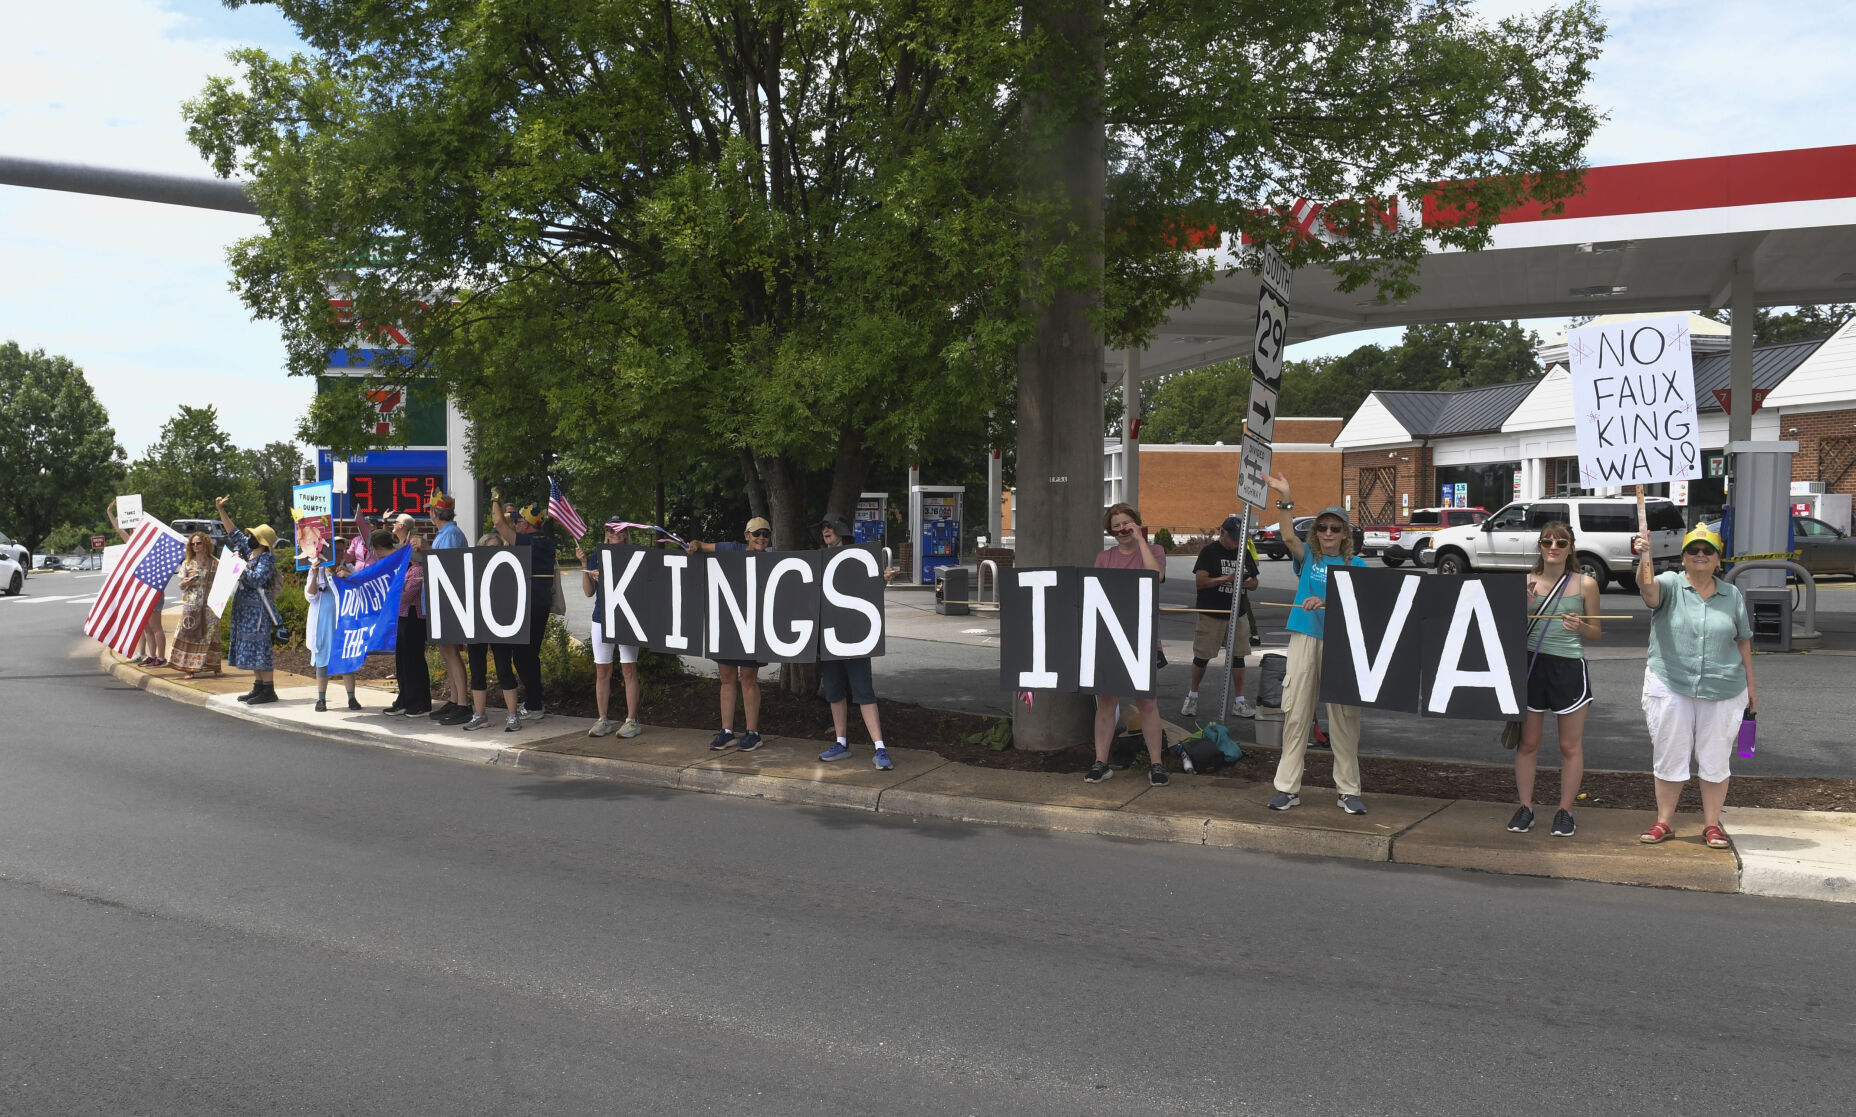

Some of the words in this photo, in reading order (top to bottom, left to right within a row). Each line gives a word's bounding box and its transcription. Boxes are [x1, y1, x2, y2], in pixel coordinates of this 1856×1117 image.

[1266, 252, 1291, 295] SOUTH
[1258, 310, 1283, 363] 29
[1599, 327, 1665, 369] NO
[1594, 370, 1684, 410] FAUX
[1720, 393, 1727, 402] 7
[1755, 392, 1762, 402] 8
[1597, 409, 1690, 448] KING
[324, 453, 368, 463] Reular
[1596, 441, 1696, 481] WAY!
[299, 494, 326, 502] TRUMPTY
[303, 504, 327, 512] DUMPTY
[341, 626, 369, 659] THE
[427, 550, 527, 640] NO
[602, 548, 883, 658] KINGS
[1018, 570, 1153, 691] IN
[1333, 570, 1520, 715] VA
